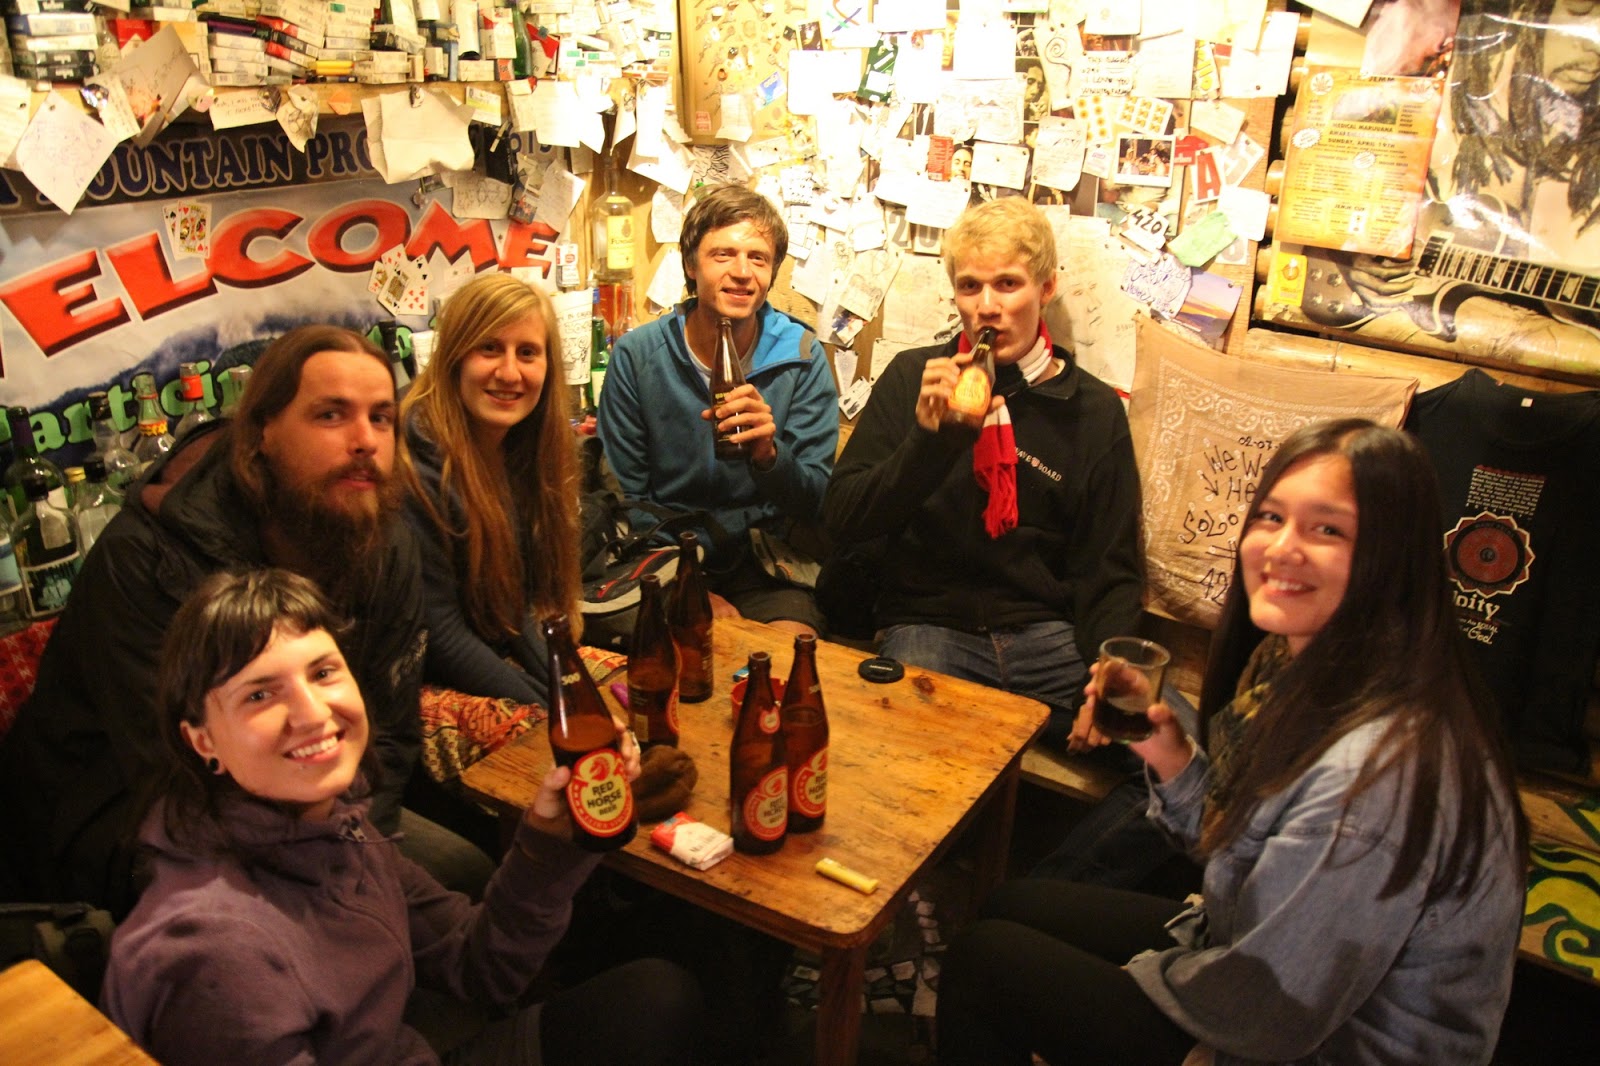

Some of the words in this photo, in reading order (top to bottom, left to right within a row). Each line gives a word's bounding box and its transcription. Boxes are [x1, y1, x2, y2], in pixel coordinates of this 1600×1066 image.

[37, 132, 306, 205] OUNTAIN
[1132, 209, 1163, 235] 420
[0, 200, 560, 360] ELCOME
[587, 788, 622, 808] HORSE
[592, 780, 615, 797] RED
